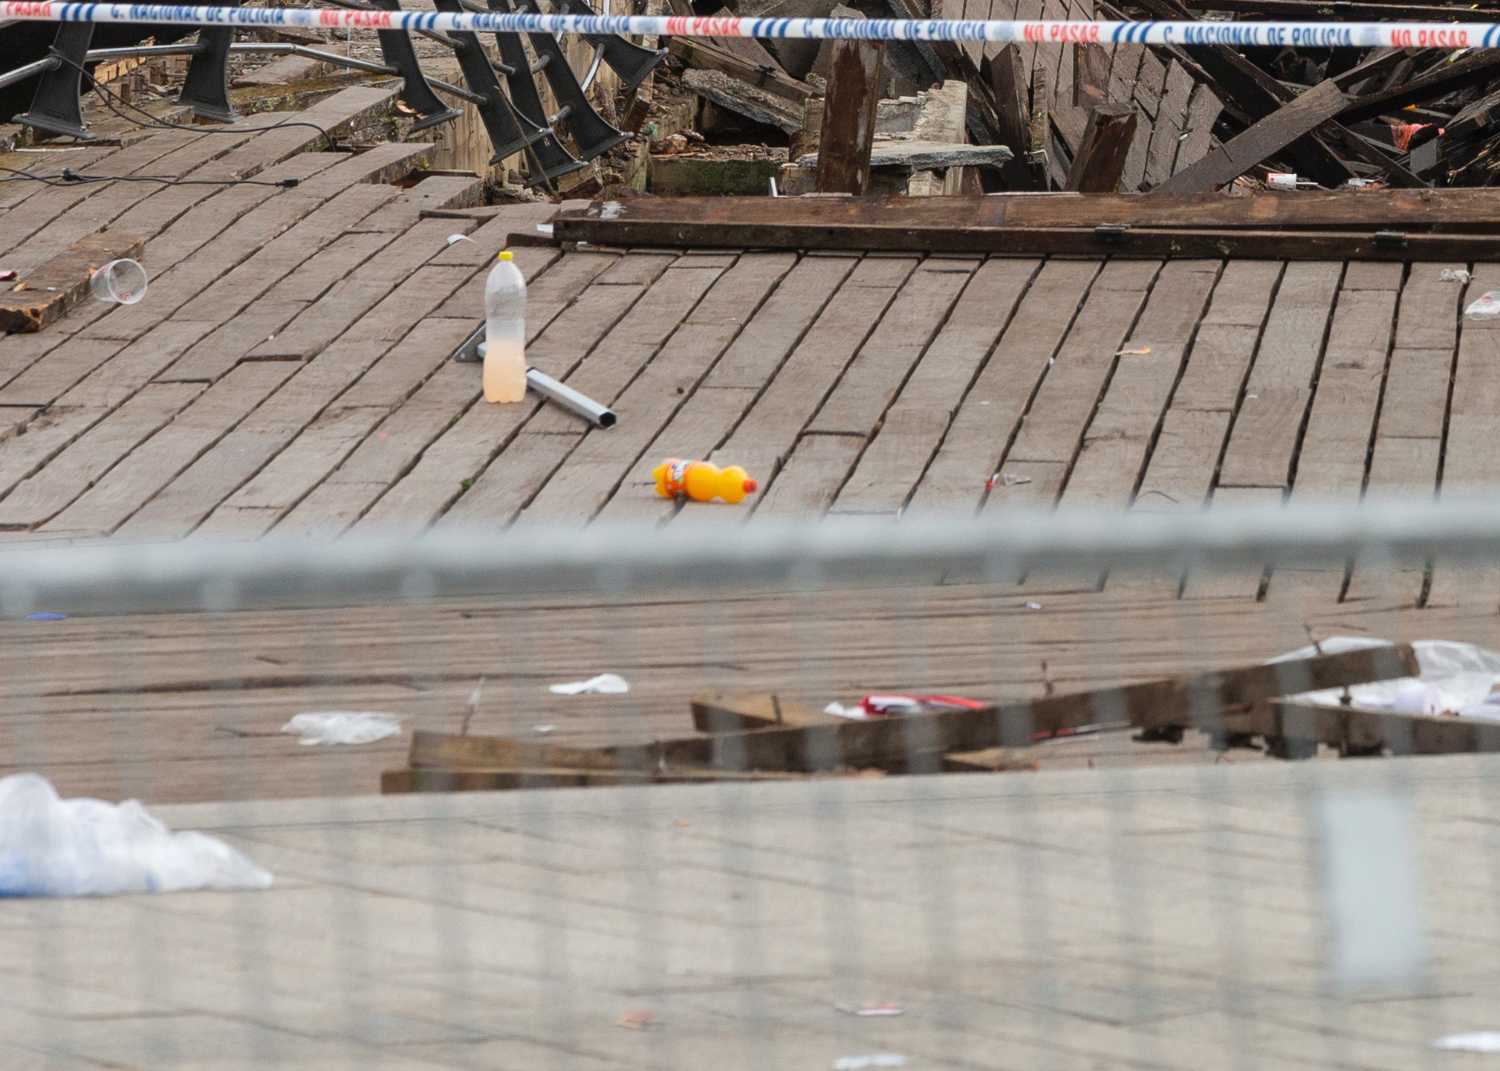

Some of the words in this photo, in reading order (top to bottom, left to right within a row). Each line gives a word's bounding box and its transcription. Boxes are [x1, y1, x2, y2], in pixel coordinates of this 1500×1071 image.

[823, 19, 896, 40] NACIONAL
[903, 21, 921, 40] DE
[927, 21, 987, 41] POLICIA
[1023, 23, 1045, 44] NO
[1050, 24, 1100, 44] PASAR
[1183, 25, 1258, 45] NACIONAL
[1267, 27, 1285, 46] DE
[1291, 27, 1353, 46] POLICIA
[1391, 29, 1412, 48] NO
[1417, 30, 1469, 48] PASAR
